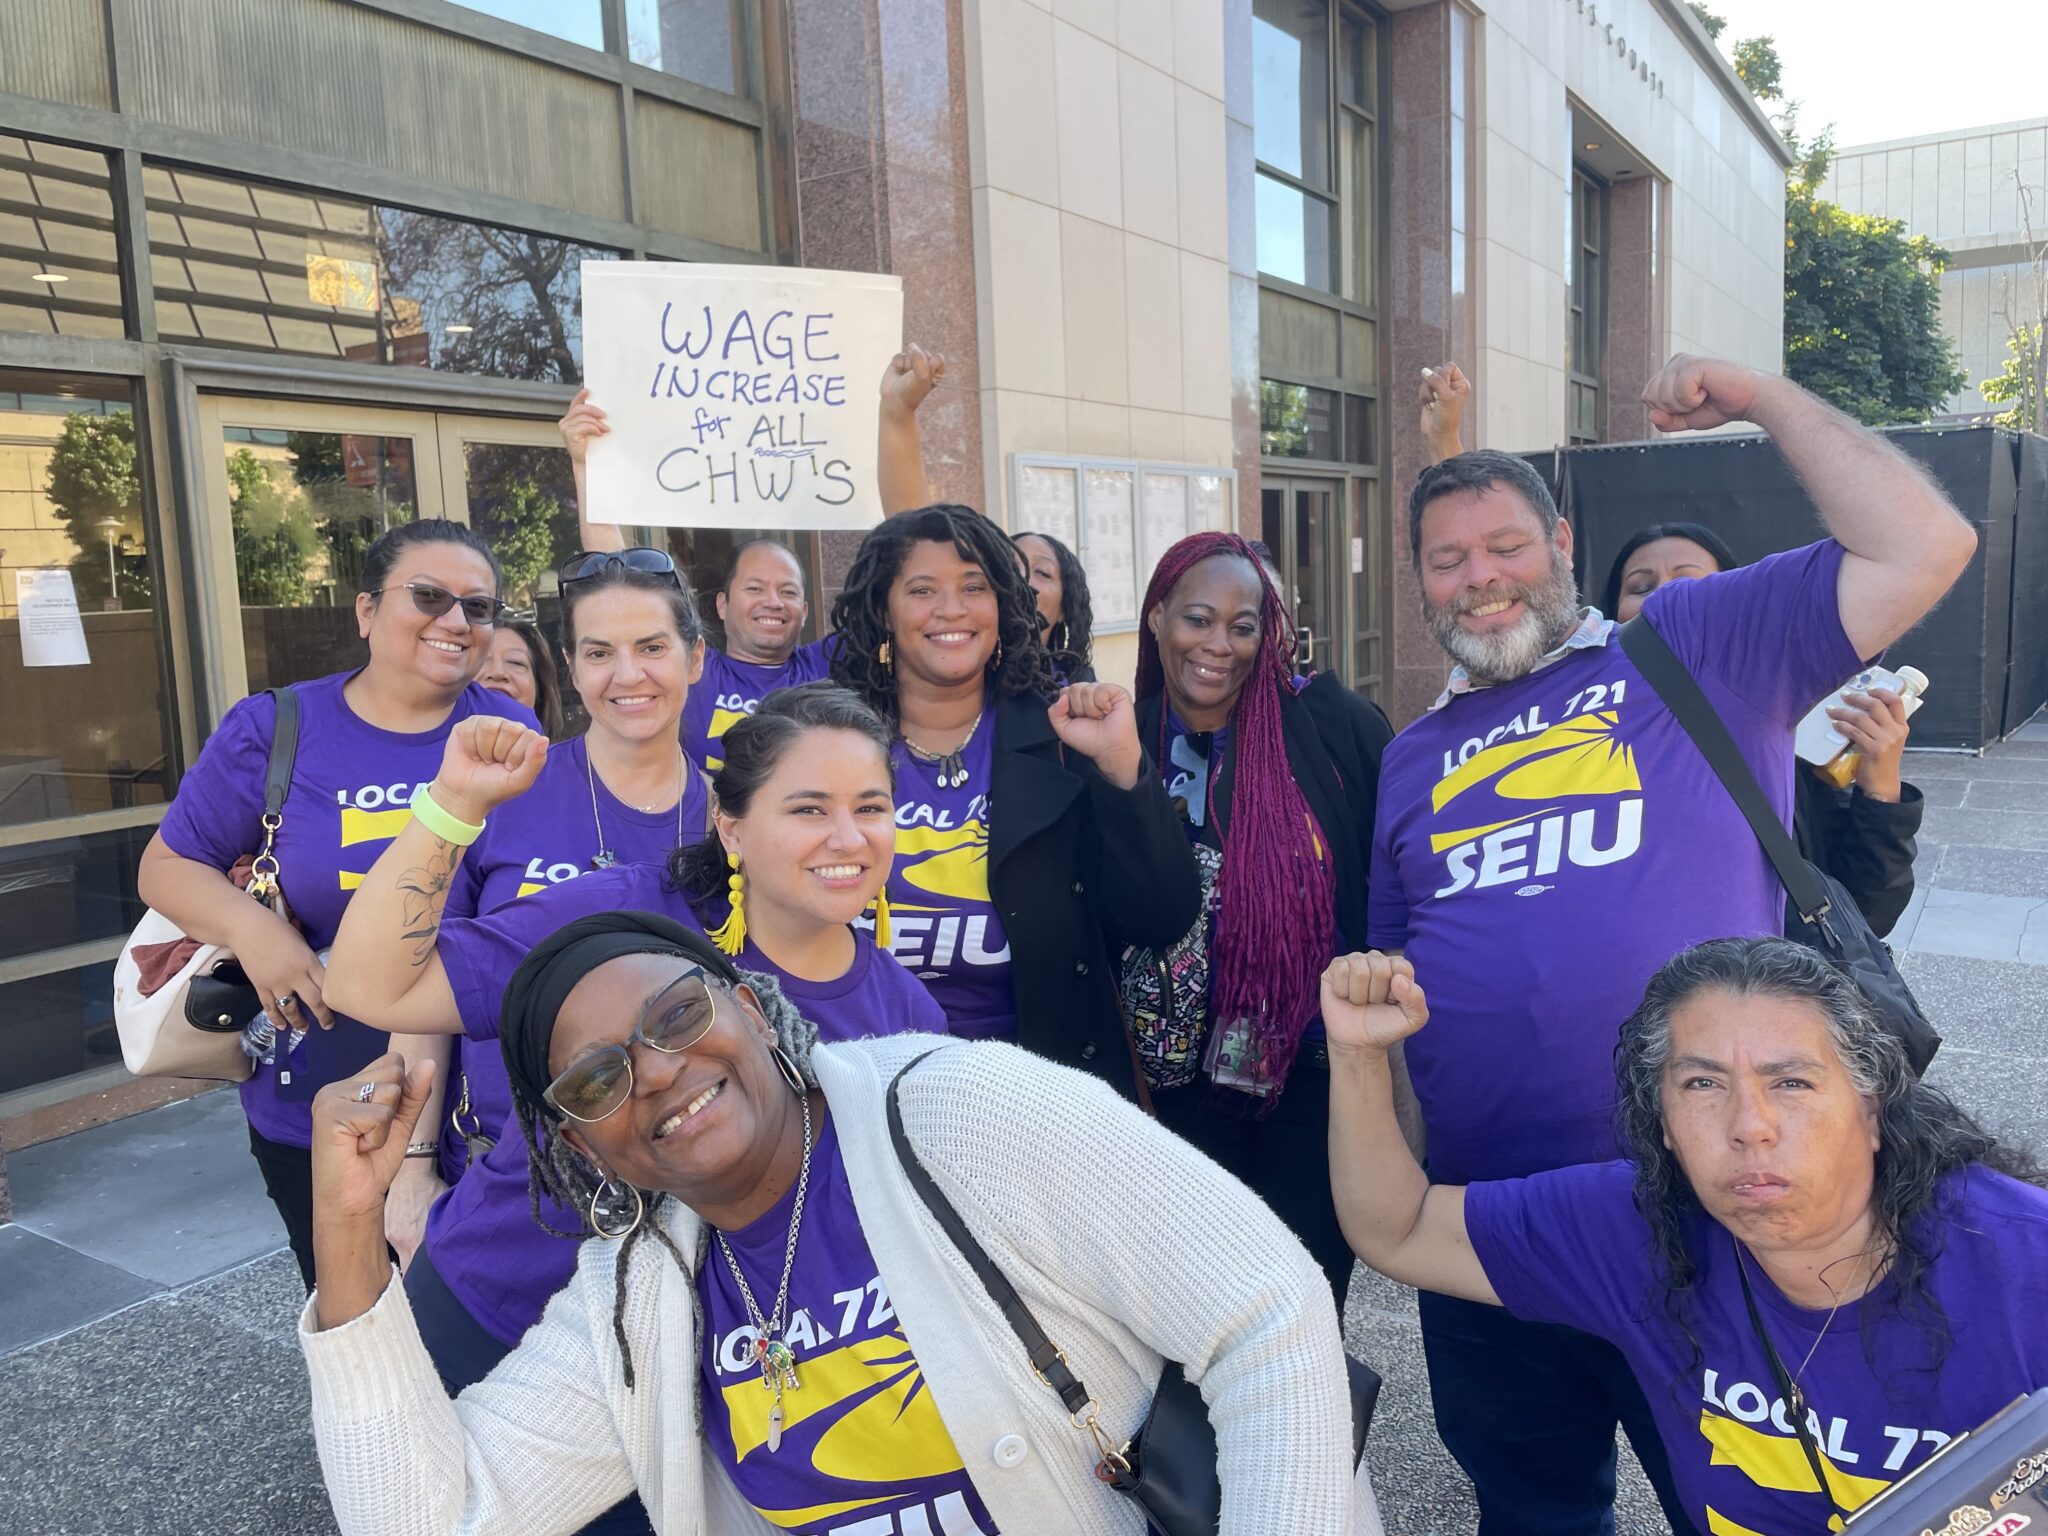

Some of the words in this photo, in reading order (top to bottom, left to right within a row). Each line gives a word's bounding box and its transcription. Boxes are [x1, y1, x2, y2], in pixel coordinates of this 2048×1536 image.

[660, 302, 840, 369] WAGE
[650, 363, 846, 406] INCREASE
[691, 406, 732, 444] for
[747, 412, 828, 448] ALL
[656, 447, 855, 505] CHW'S
[715, 693, 759, 714] LOC
[895, 801, 954, 828] CAL
[1434, 798, 1644, 898] SEIU
[833, 1275, 894, 1339] 72
